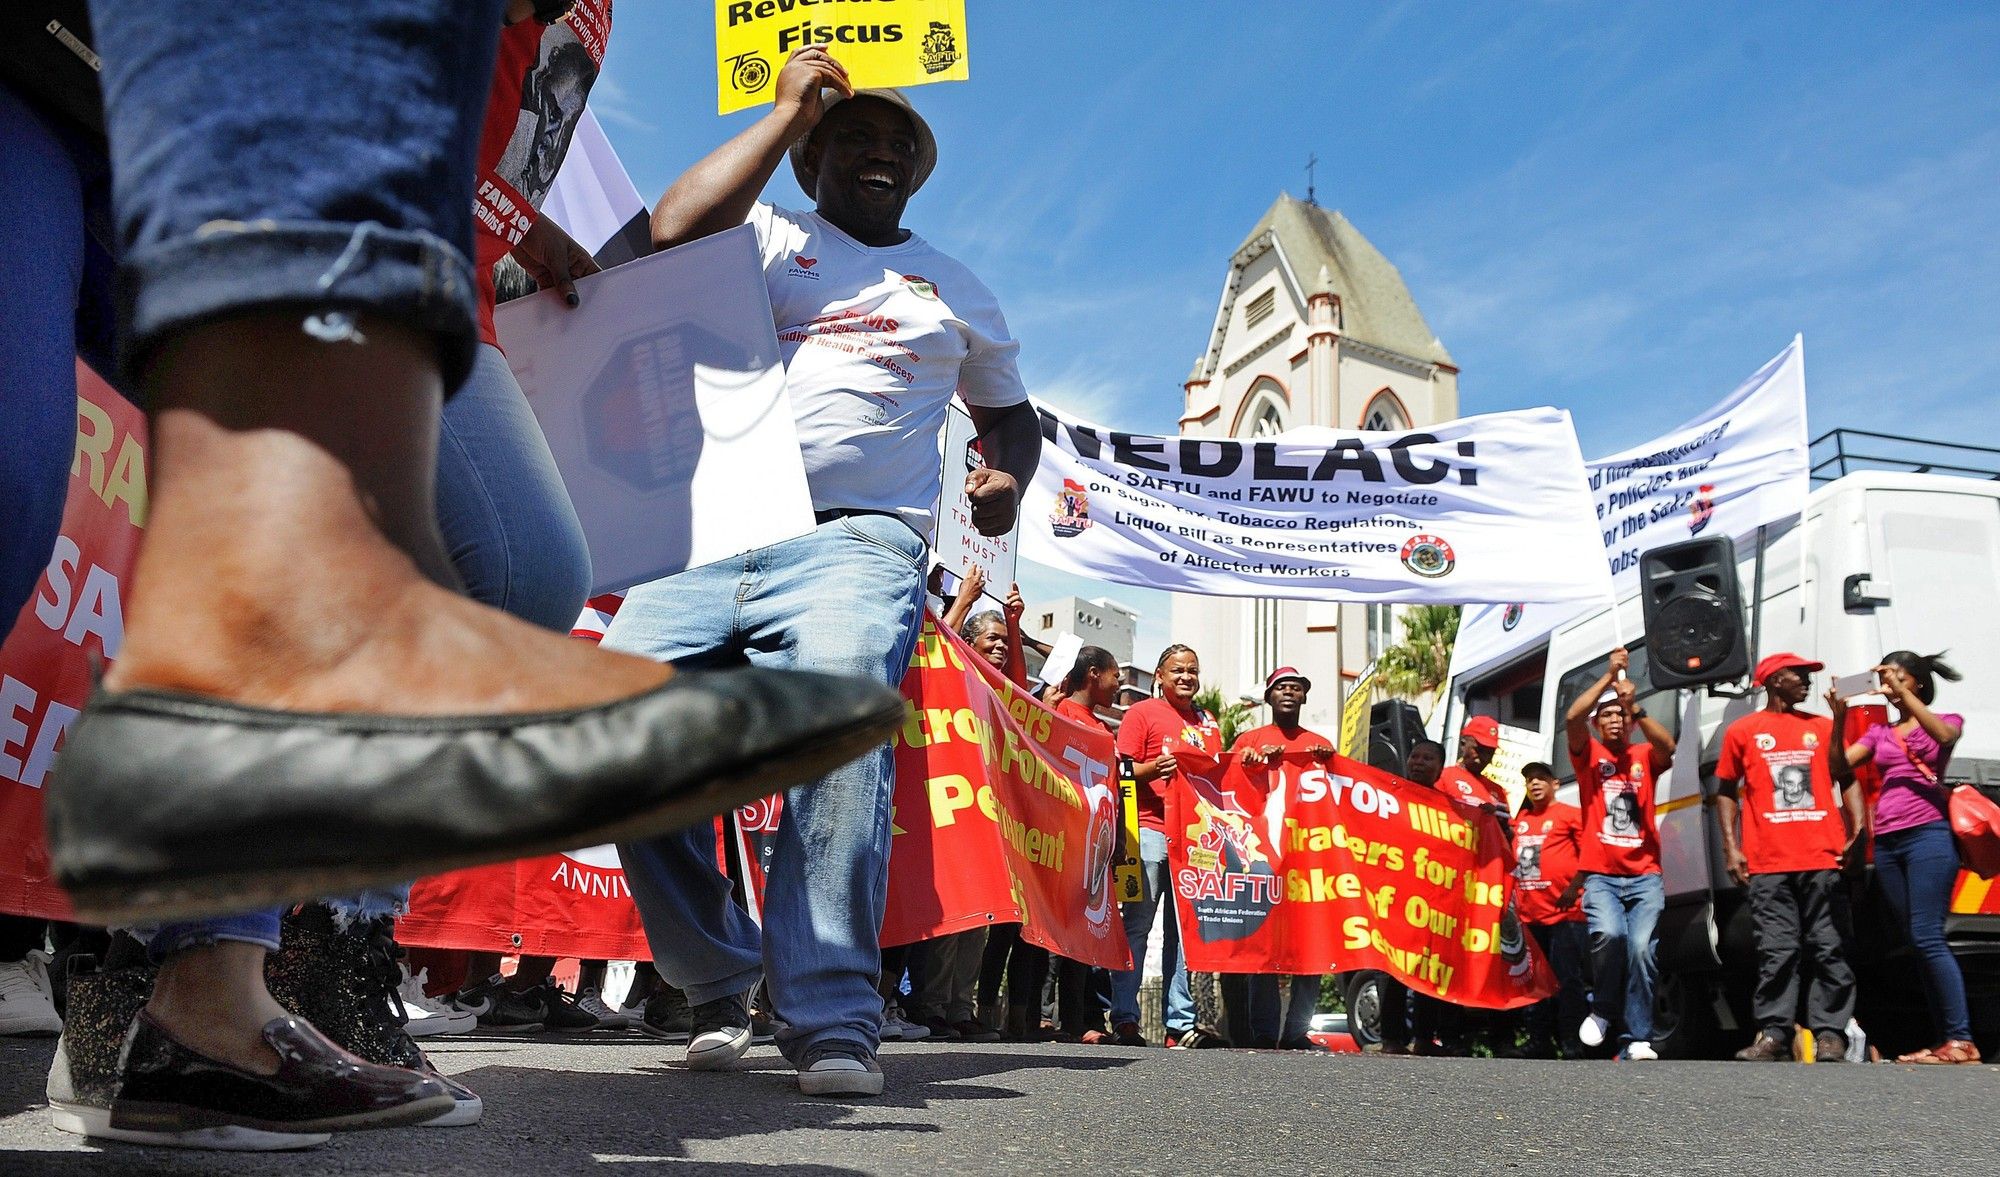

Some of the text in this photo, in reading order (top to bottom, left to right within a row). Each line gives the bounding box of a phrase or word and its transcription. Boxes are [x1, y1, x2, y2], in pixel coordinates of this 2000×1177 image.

[778, 20, 903, 54] Fiscus
[478, 180, 516, 216] FAWU
[883, 357, 916, 383] Access
[1089, 481, 1111, 495] on
[1117, 488, 1166, 507] Sugar
[1217, 511, 1298, 529] Tobacco
[1304, 516, 1424, 533] Regulations,
[1126, 472, 1438, 507] SAFTU and FAWU to Negotiate
[1115, 511, 1397, 554] Liquor Bill as Representatives
[1622, 511, 1647, 539] the
[961, 534, 997, 564] MUST
[1159, 550, 1350, 578] of Affected Workers
[1299, 768, 1401, 819] STOP
[551, 861, 632, 899] ANNIV
[1412, 846, 1458, 889] for
[1178, 868, 1283, 905] SAFTU
[1287, 868, 1361, 903] Sake
[1404, 894, 1458, 938] Our
[1342, 915, 1454, 997] Security
